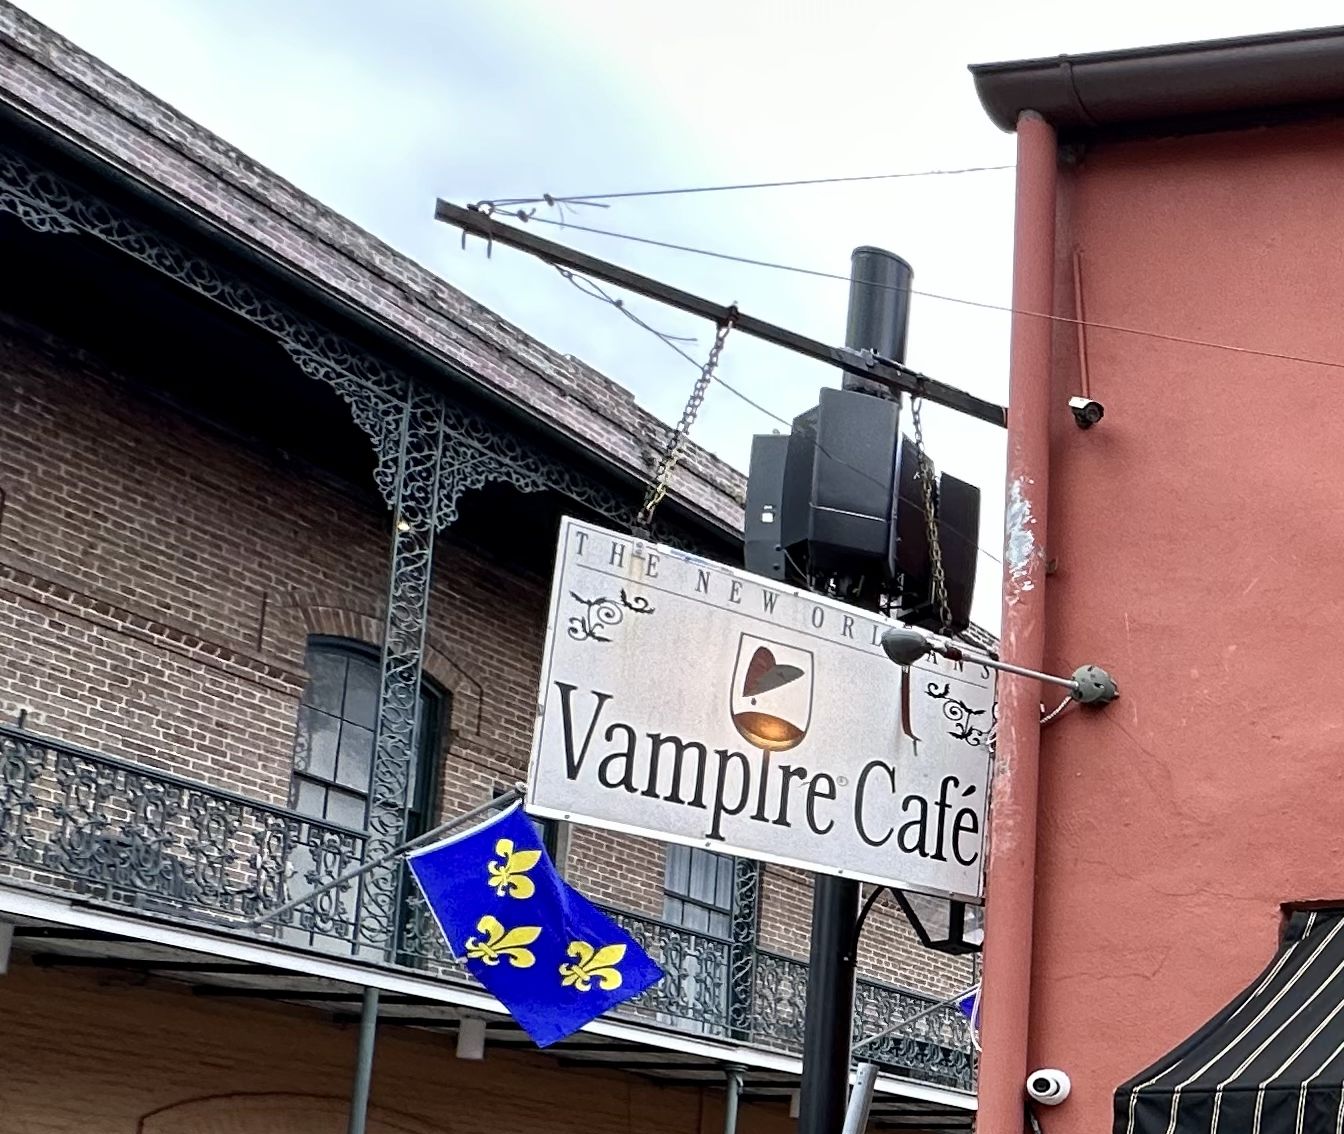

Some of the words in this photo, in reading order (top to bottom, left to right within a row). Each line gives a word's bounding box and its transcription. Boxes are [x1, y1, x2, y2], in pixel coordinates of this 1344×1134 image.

[574, 532, 661, 579] THE
[696, 569, 780, 617] NEW
[812, 606, 992, 680] ORLANS
[855, 760, 980, 866] Café
